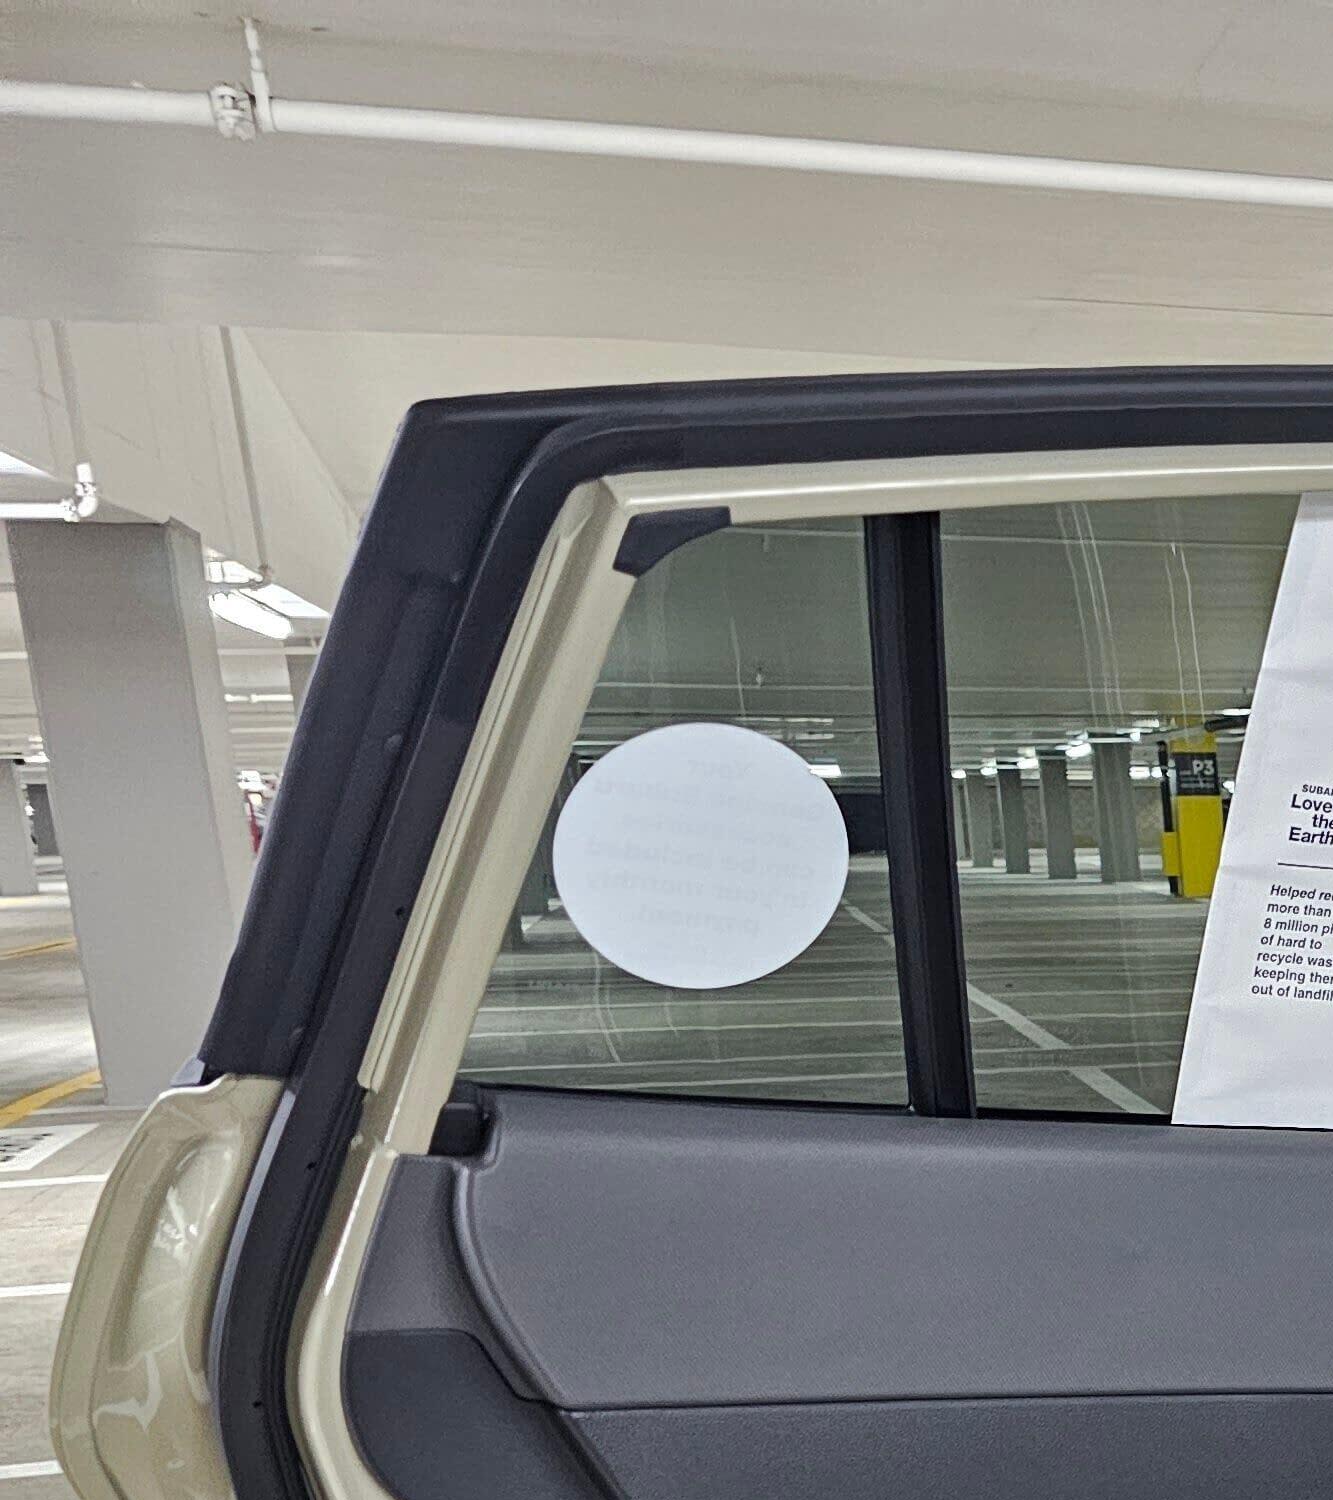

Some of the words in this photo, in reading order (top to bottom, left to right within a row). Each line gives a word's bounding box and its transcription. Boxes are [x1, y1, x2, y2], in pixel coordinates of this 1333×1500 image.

[1193, 759, 1216, 776] P3
[1270, 884, 1317, 900] Helped
[1266, 903, 1300, 915] more
[1303, 904, 1332, 918] than
[1263, 917, 1272, 929] 8
[1274, 919, 1319, 933] million
[1260, 934, 1275, 946] of
[1276, 935, 1307, 949] hard
[1309, 938, 1322, 950] to
[1256, 952, 1304, 966] recycle
[1254, 965, 1306, 985] keeping
[1251, 984, 1273, 996] out
[1277, 985, 1291, 997] of
